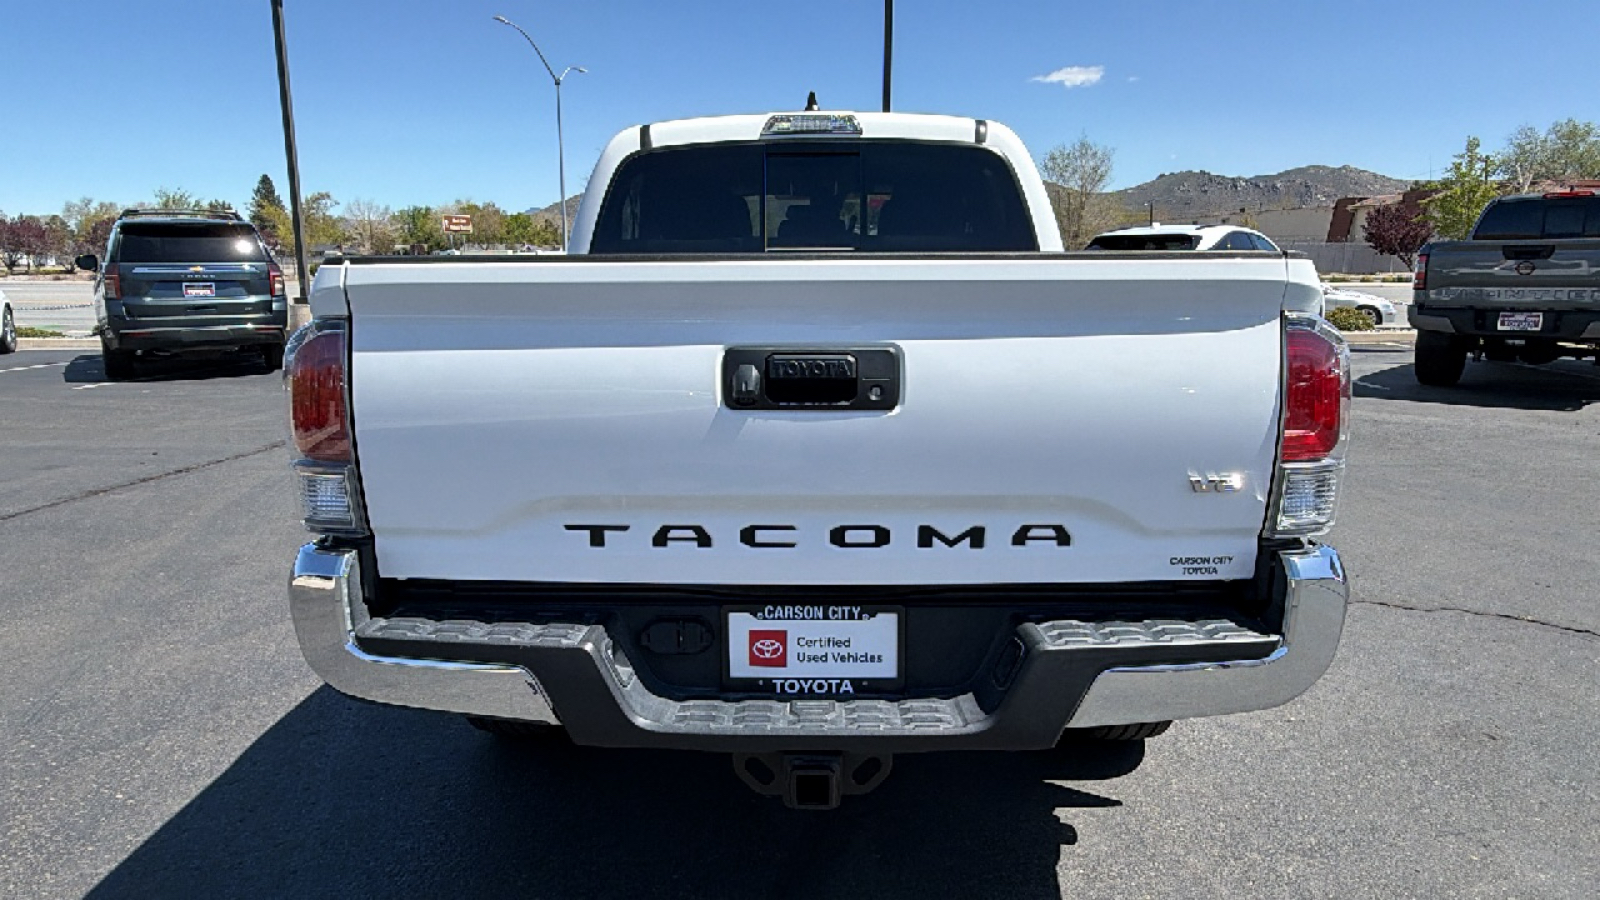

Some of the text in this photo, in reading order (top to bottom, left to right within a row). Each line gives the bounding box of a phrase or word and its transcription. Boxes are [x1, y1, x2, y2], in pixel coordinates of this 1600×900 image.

[773, 360, 852, 377] TOYOTA
[564, 524, 1072, 549] TACOMA
[1169, 556, 1233, 566] CARSON CITY
[1182, 566, 1218, 575] TOYOTA
[765, 605, 861, 619] CARSON CITY
[797, 637, 851, 648] Certified
[797, 652, 883, 663] Used Vehicles
[772, 679, 854, 694] TOYOTA
